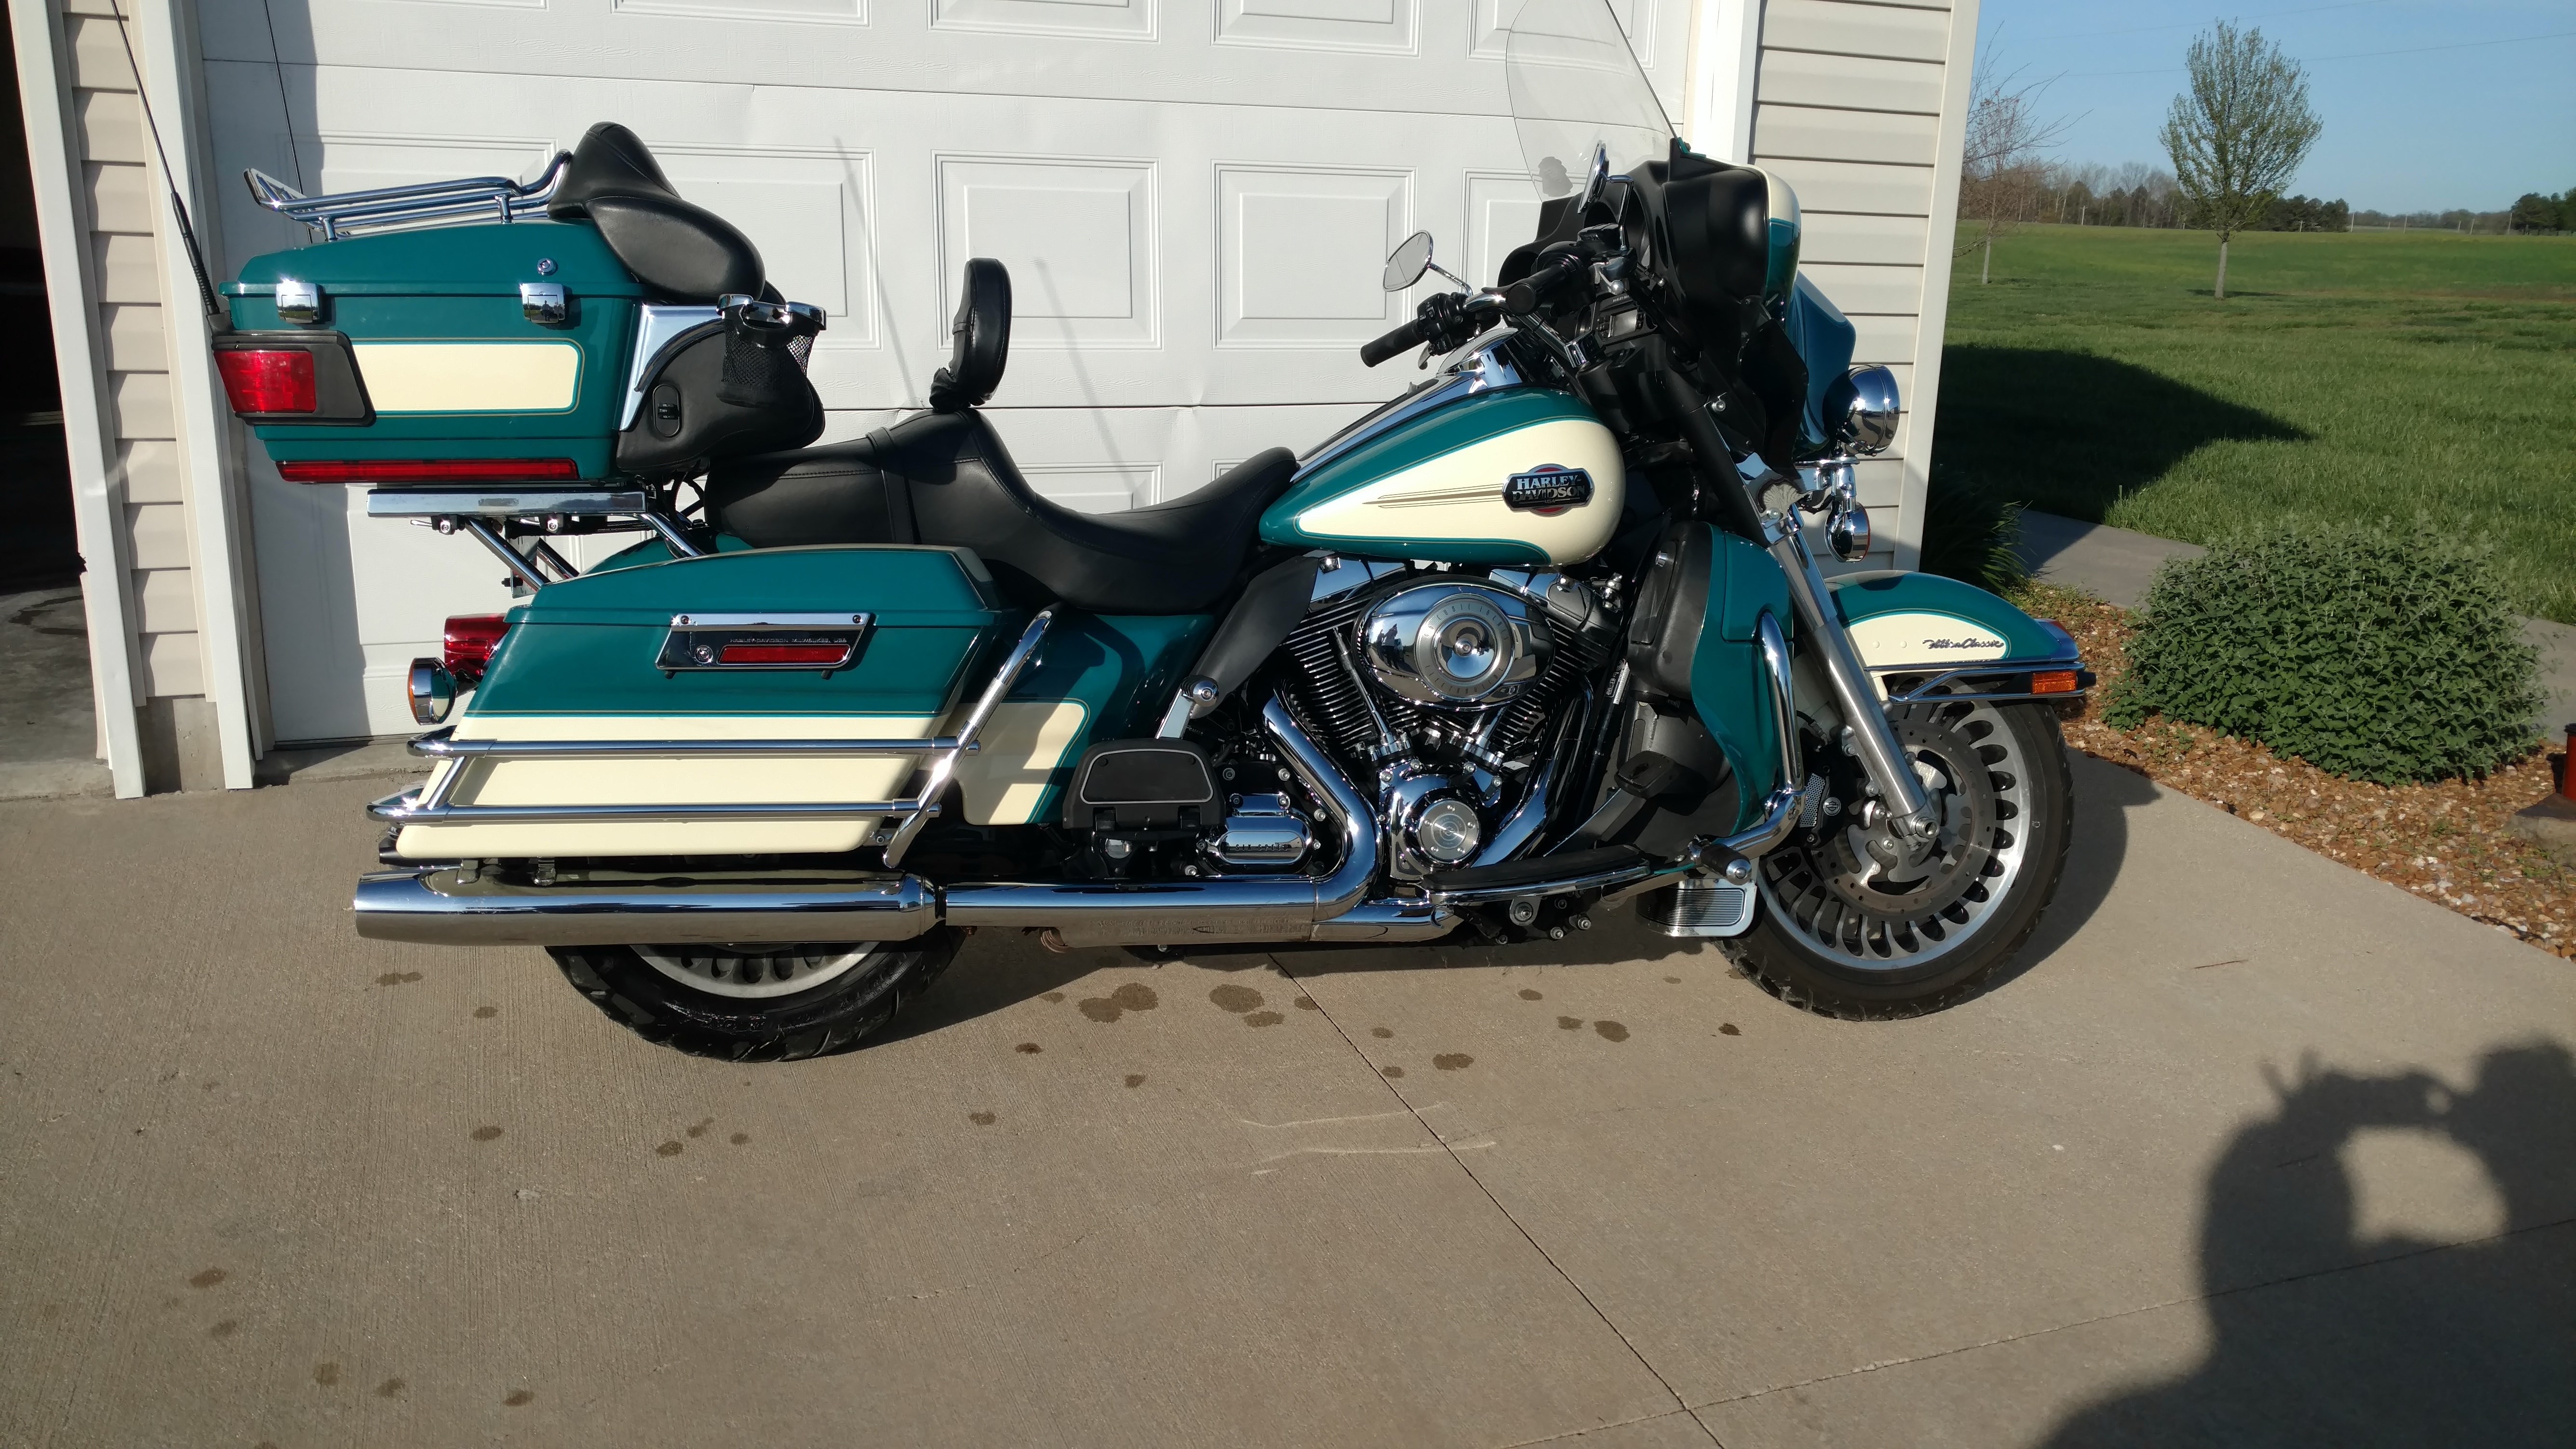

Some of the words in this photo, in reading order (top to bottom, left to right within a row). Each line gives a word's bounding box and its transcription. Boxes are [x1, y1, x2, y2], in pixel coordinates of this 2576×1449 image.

[1517, 475, 1581, 490] HARLEY-
[1512, 486, 1585, 502] DAVIDSON
[1437, 604, 1470, 620] CUBIC
[1480, 606, 1508, 640] INCHES
[1962, 638, 2004, 649] Classic
